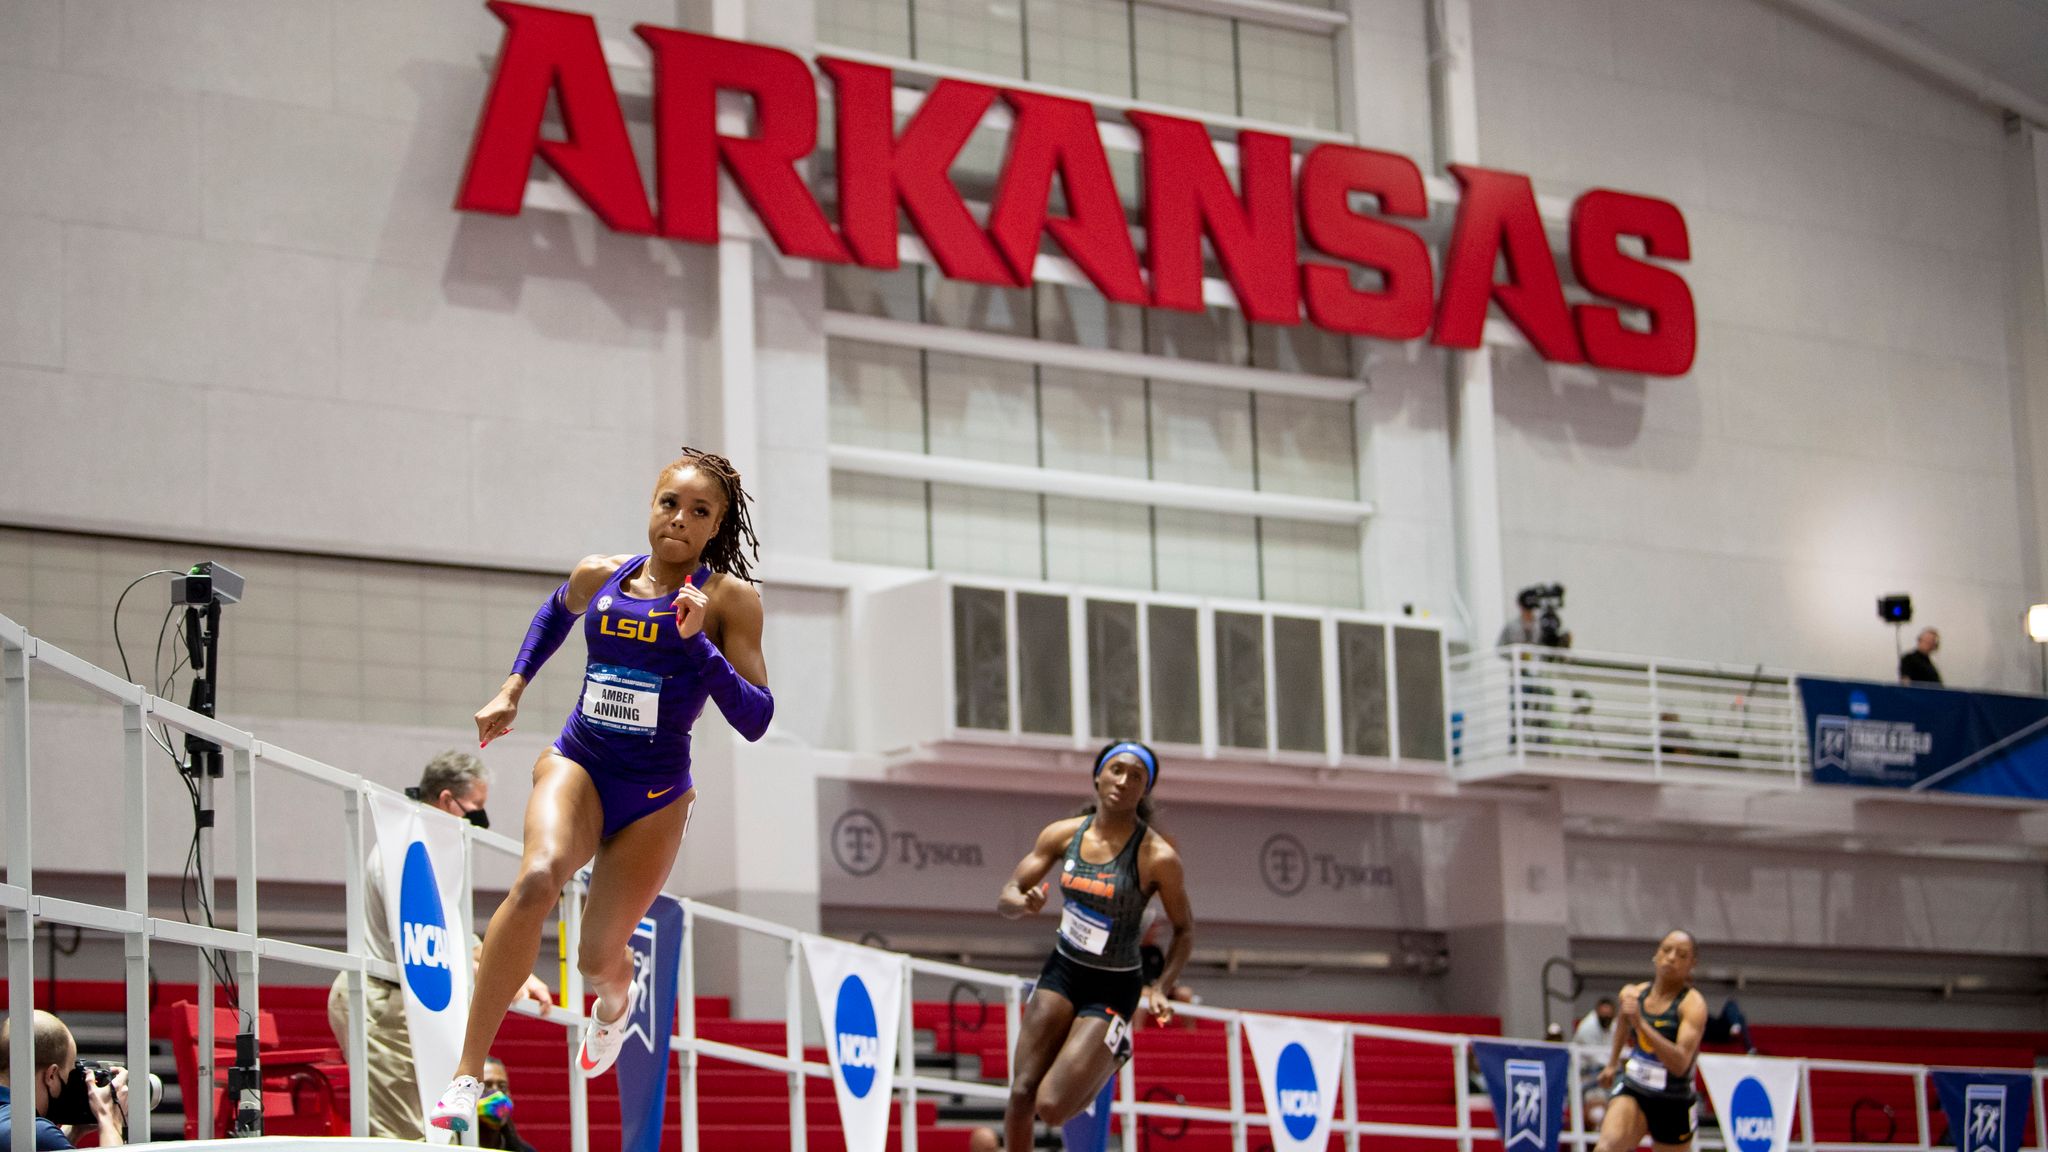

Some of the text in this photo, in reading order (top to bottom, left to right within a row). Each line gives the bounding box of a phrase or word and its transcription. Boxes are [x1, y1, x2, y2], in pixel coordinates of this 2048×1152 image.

[453, 0, 1696, 377] ARKANSAS
[600, 615, 659, 643] LSU
[601, 688, 635, 705] AMBER
[593, 701, 640, 722] ANNING
[892, 831, 984, 870] Tyson
[1312, 853, 1394, 890] Tyson
[1109, 1020, 1124, 1047] 5
[839, 1032, 880, 1069] NCAA
[1279, 1088, 1320, 1117] NCAA
[1734, 1116, 1776, 1141] NCAA
